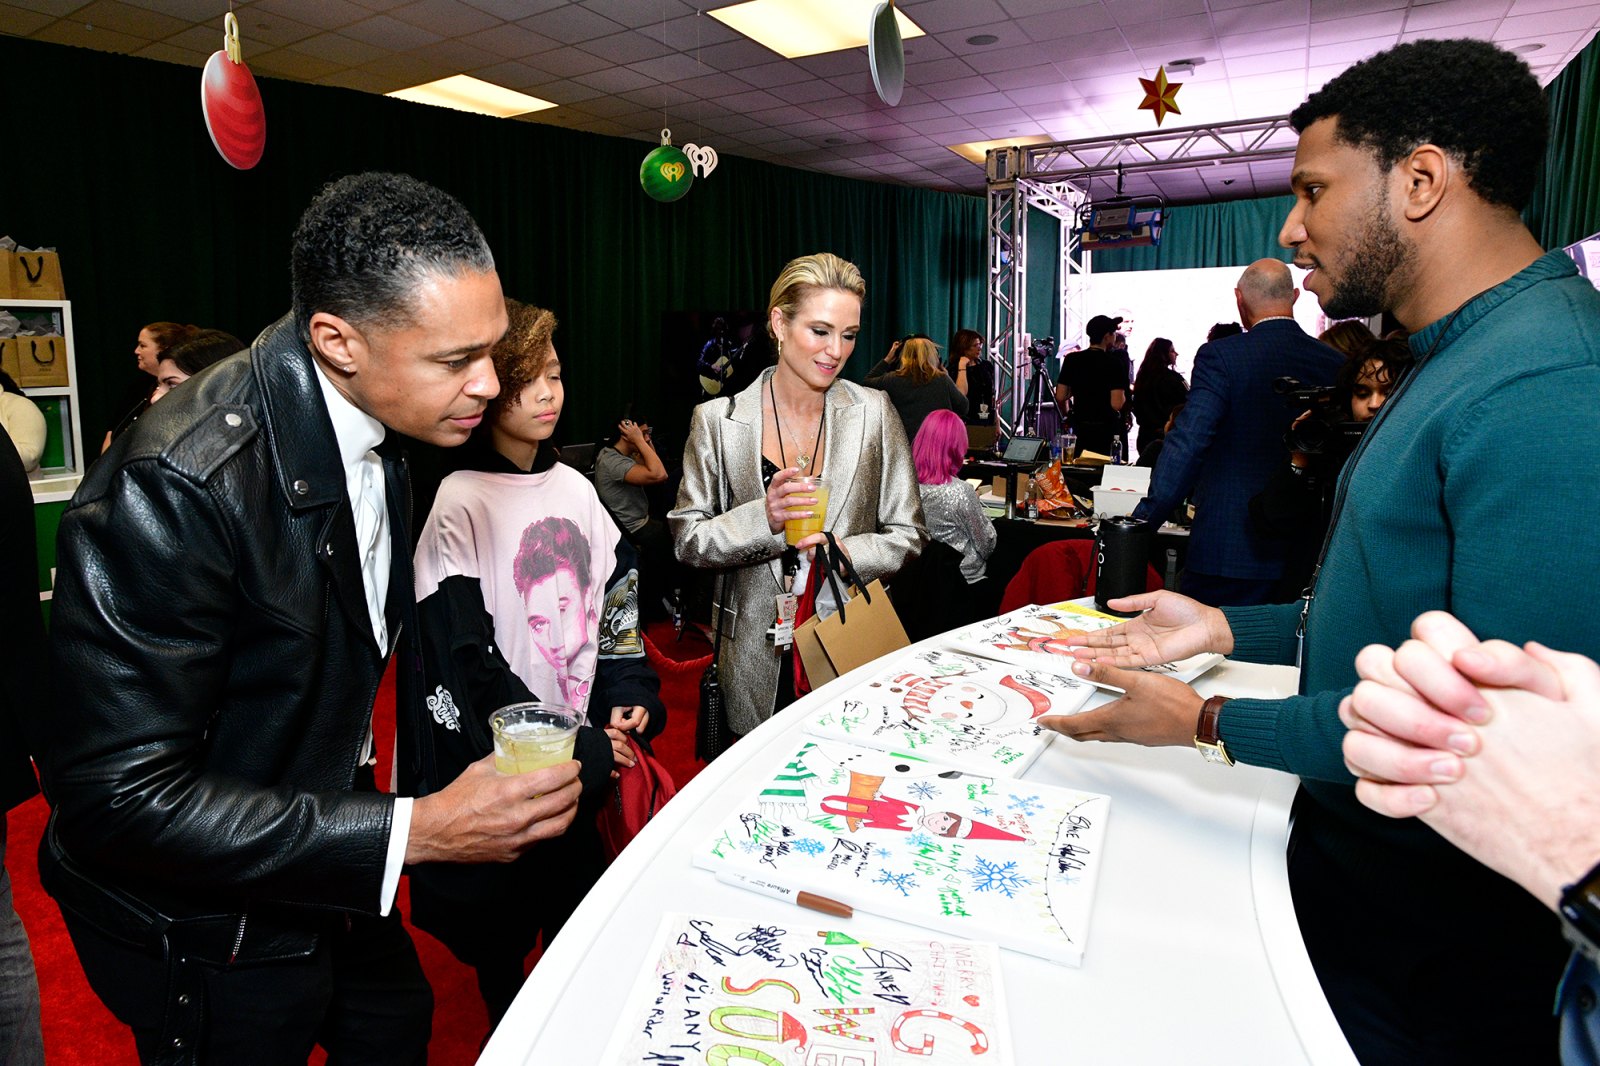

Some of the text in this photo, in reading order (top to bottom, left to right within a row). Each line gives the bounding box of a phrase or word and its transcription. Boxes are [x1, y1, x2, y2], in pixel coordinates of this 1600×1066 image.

[950, 943, 974, 991] MERRY
[670, 995, 702, 1053] LANY
[890, 1009, 990, 1056] G
